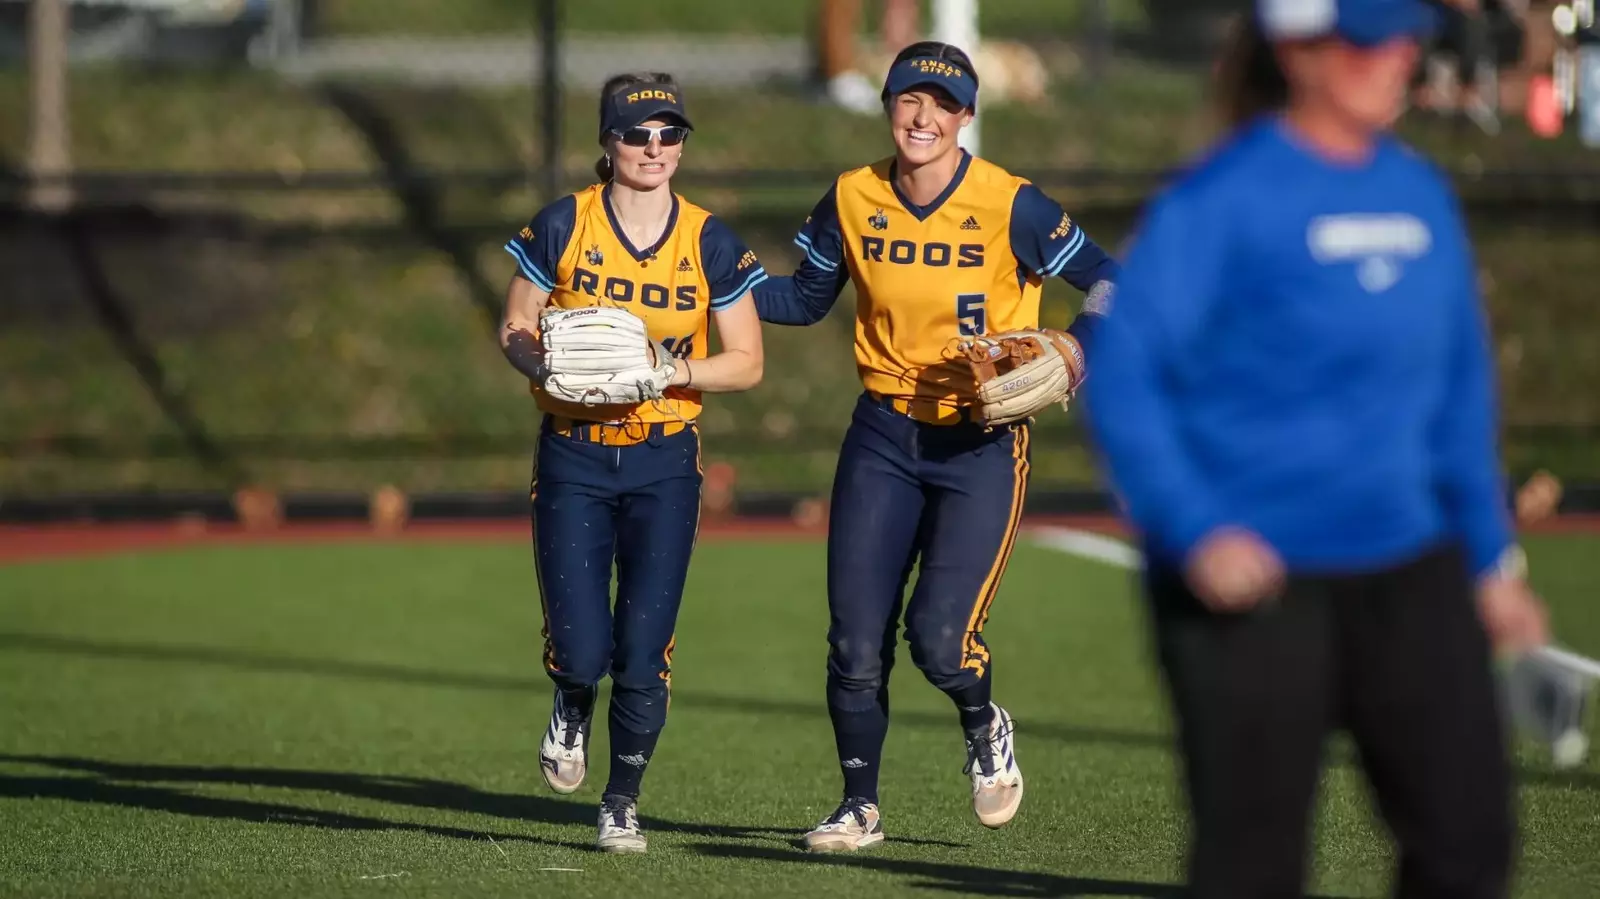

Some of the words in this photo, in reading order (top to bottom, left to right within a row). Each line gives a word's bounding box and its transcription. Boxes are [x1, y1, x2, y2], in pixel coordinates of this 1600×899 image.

[910, 59, 962, 77] KANSAS
[921, 66, 951, 78] CITY
[626, 90, 677, 105] ROOS
[861, 235, 985, 268] ROOS
[572, 267, 697, 312] ROOS
[561, 308, 599, 321] A2000
[956, 293, 985, 337] 5
